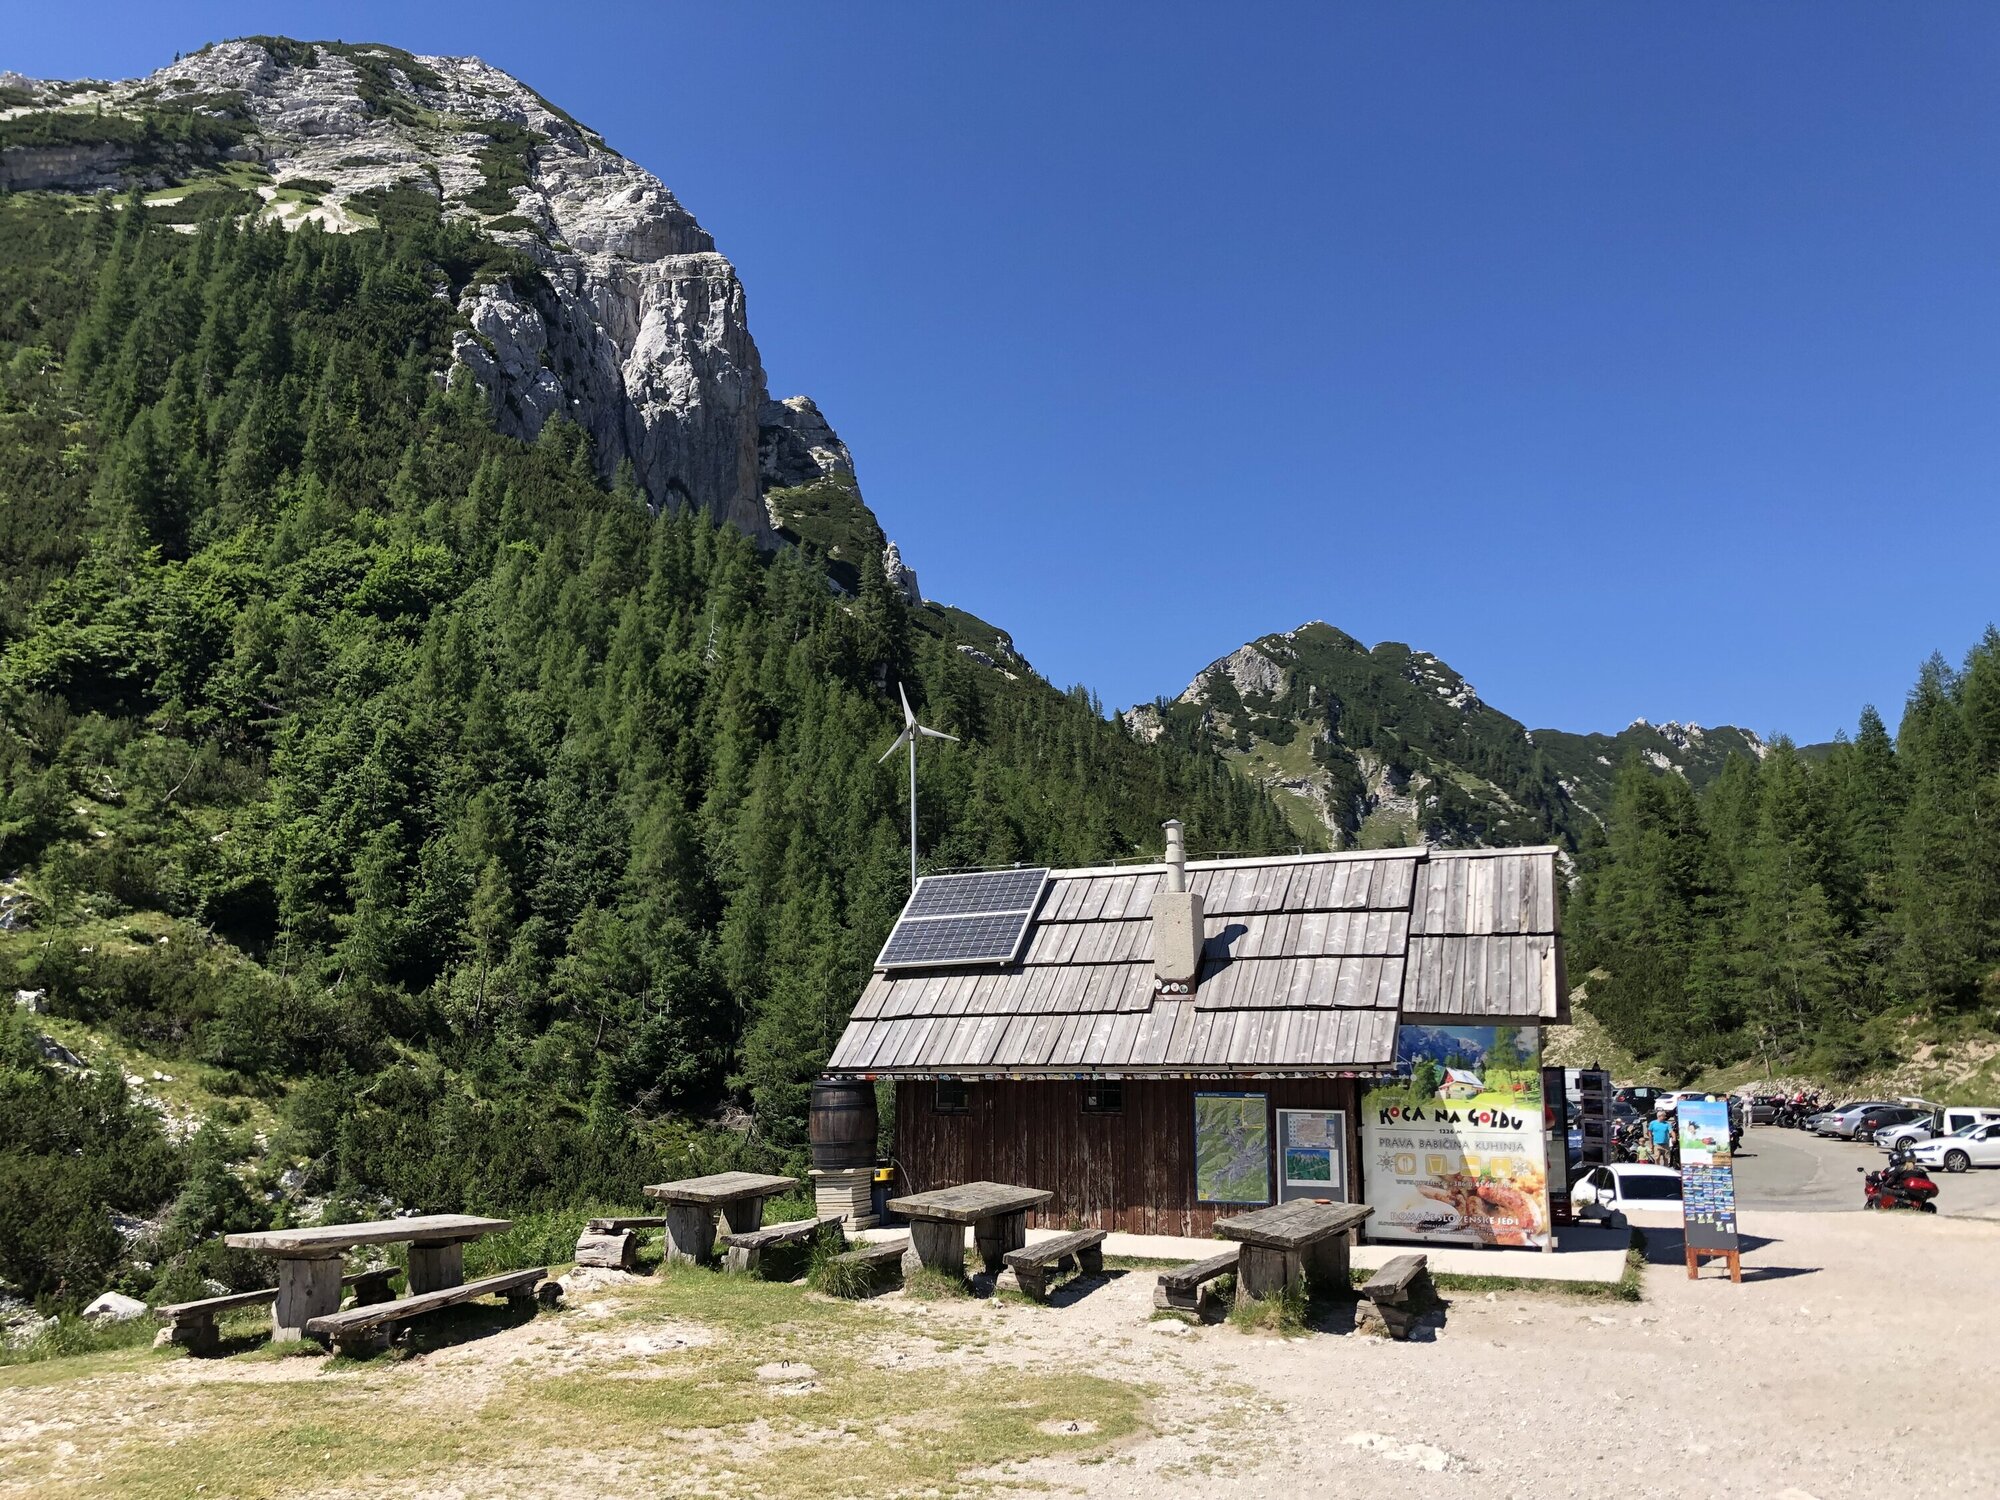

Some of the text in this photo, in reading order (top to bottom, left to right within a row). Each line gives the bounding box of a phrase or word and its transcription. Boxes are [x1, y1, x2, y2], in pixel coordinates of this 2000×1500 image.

[1435, 1109, 1461, 1124] NA
[1467, 1108, 1523, 1130] GOZDU
[1378, 1137, 1525, 1152] PRAVA BABIČINA KUHINJA
[1437, 1212, 1494, 1225] SLOVENSKE
[1496, 1216, 1519, 1226] JEDI
